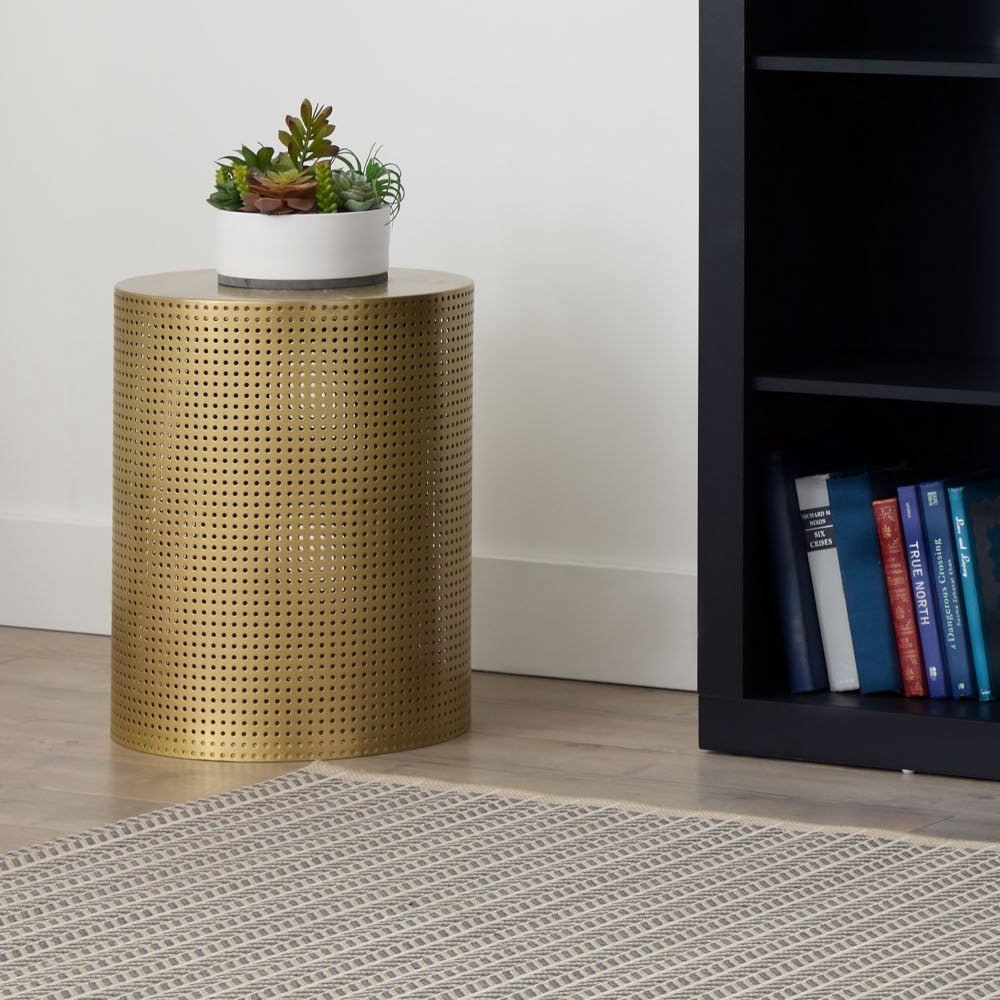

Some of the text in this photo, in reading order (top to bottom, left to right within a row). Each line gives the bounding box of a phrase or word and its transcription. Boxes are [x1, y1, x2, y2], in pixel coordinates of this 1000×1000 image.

[809, 518, 826, 526] NIXON
[814, 530, 825, 538] SIX
[810, 538, 833, 548] CRISES
[934, 538, 946, 584] Crossing
[909, 541, 930, 625] TRUE NORTH
[942, 586, 956, 641] Dangerous
